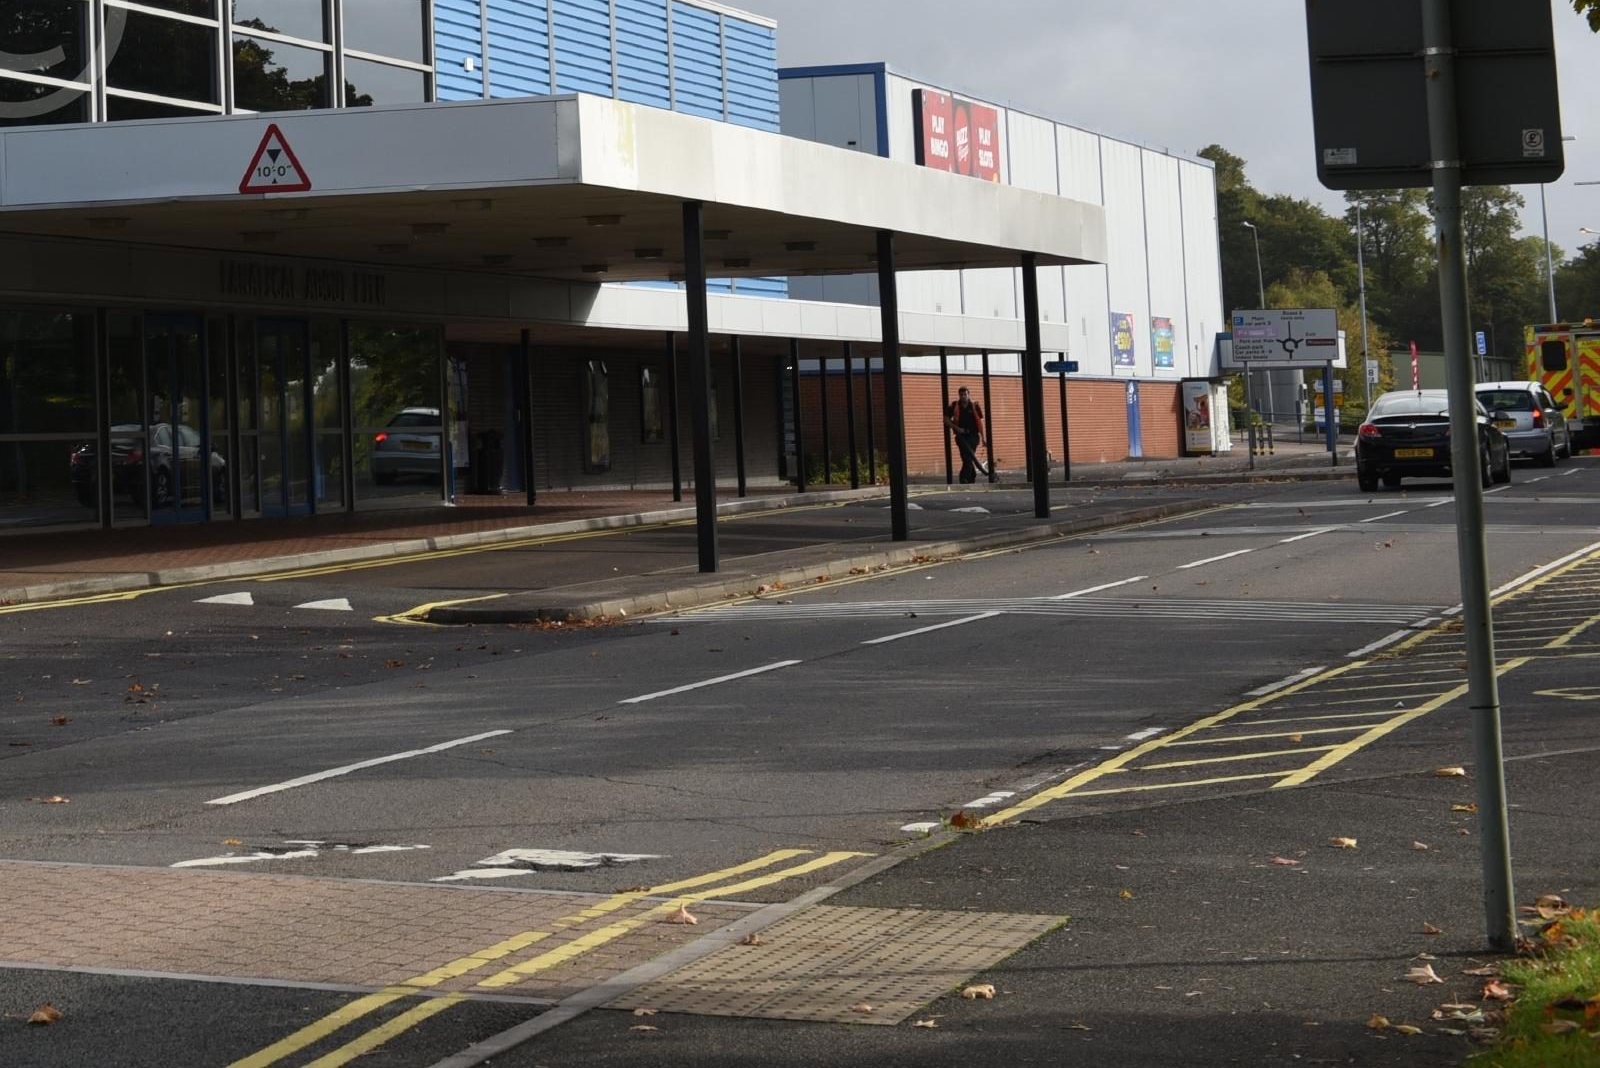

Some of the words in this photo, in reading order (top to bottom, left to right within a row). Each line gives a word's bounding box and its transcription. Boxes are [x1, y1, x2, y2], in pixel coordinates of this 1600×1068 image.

[931, 115, 945, 134] PLAY
[978, 127, 991, 146] PLAY
[930, 137, 949, 158] BINGO
